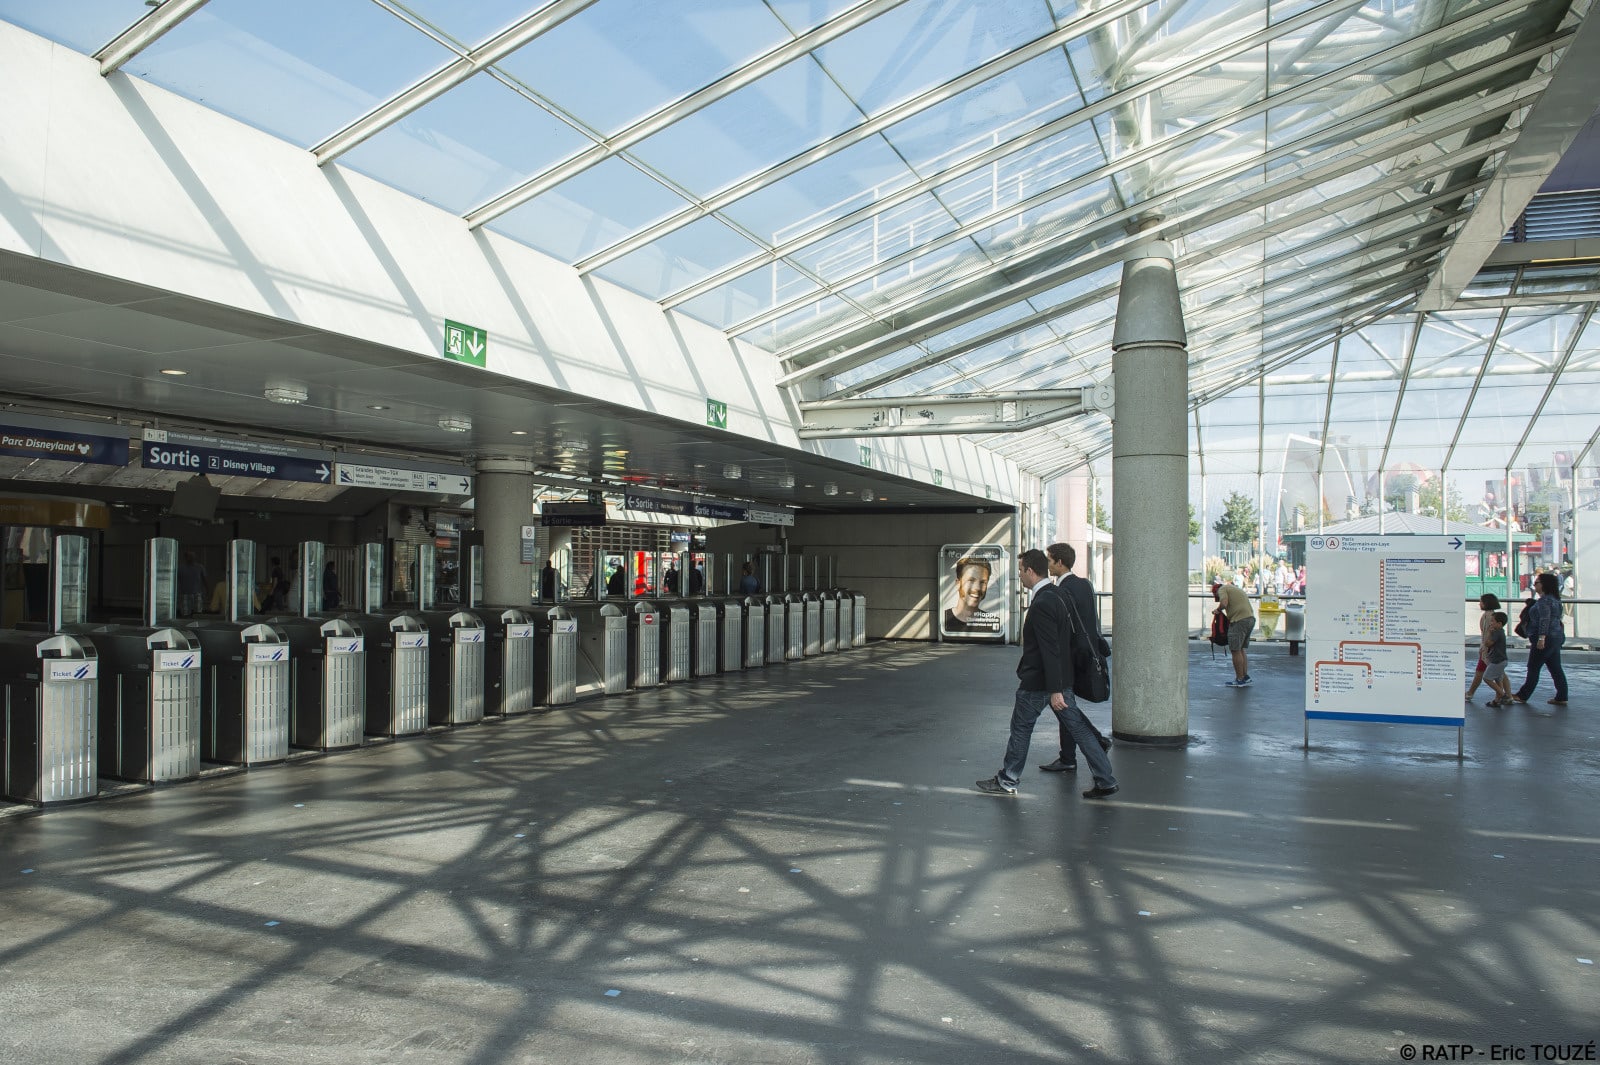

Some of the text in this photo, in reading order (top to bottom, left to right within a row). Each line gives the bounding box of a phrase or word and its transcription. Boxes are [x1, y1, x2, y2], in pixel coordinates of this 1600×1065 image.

[2, 436, 76, 451] Parc Disneyland
[150, 447, 275, 473] Sortie 2 Disney Village
[635, 499, 653, 510] Sortie
[695, 505, 710, 515] Sortie
